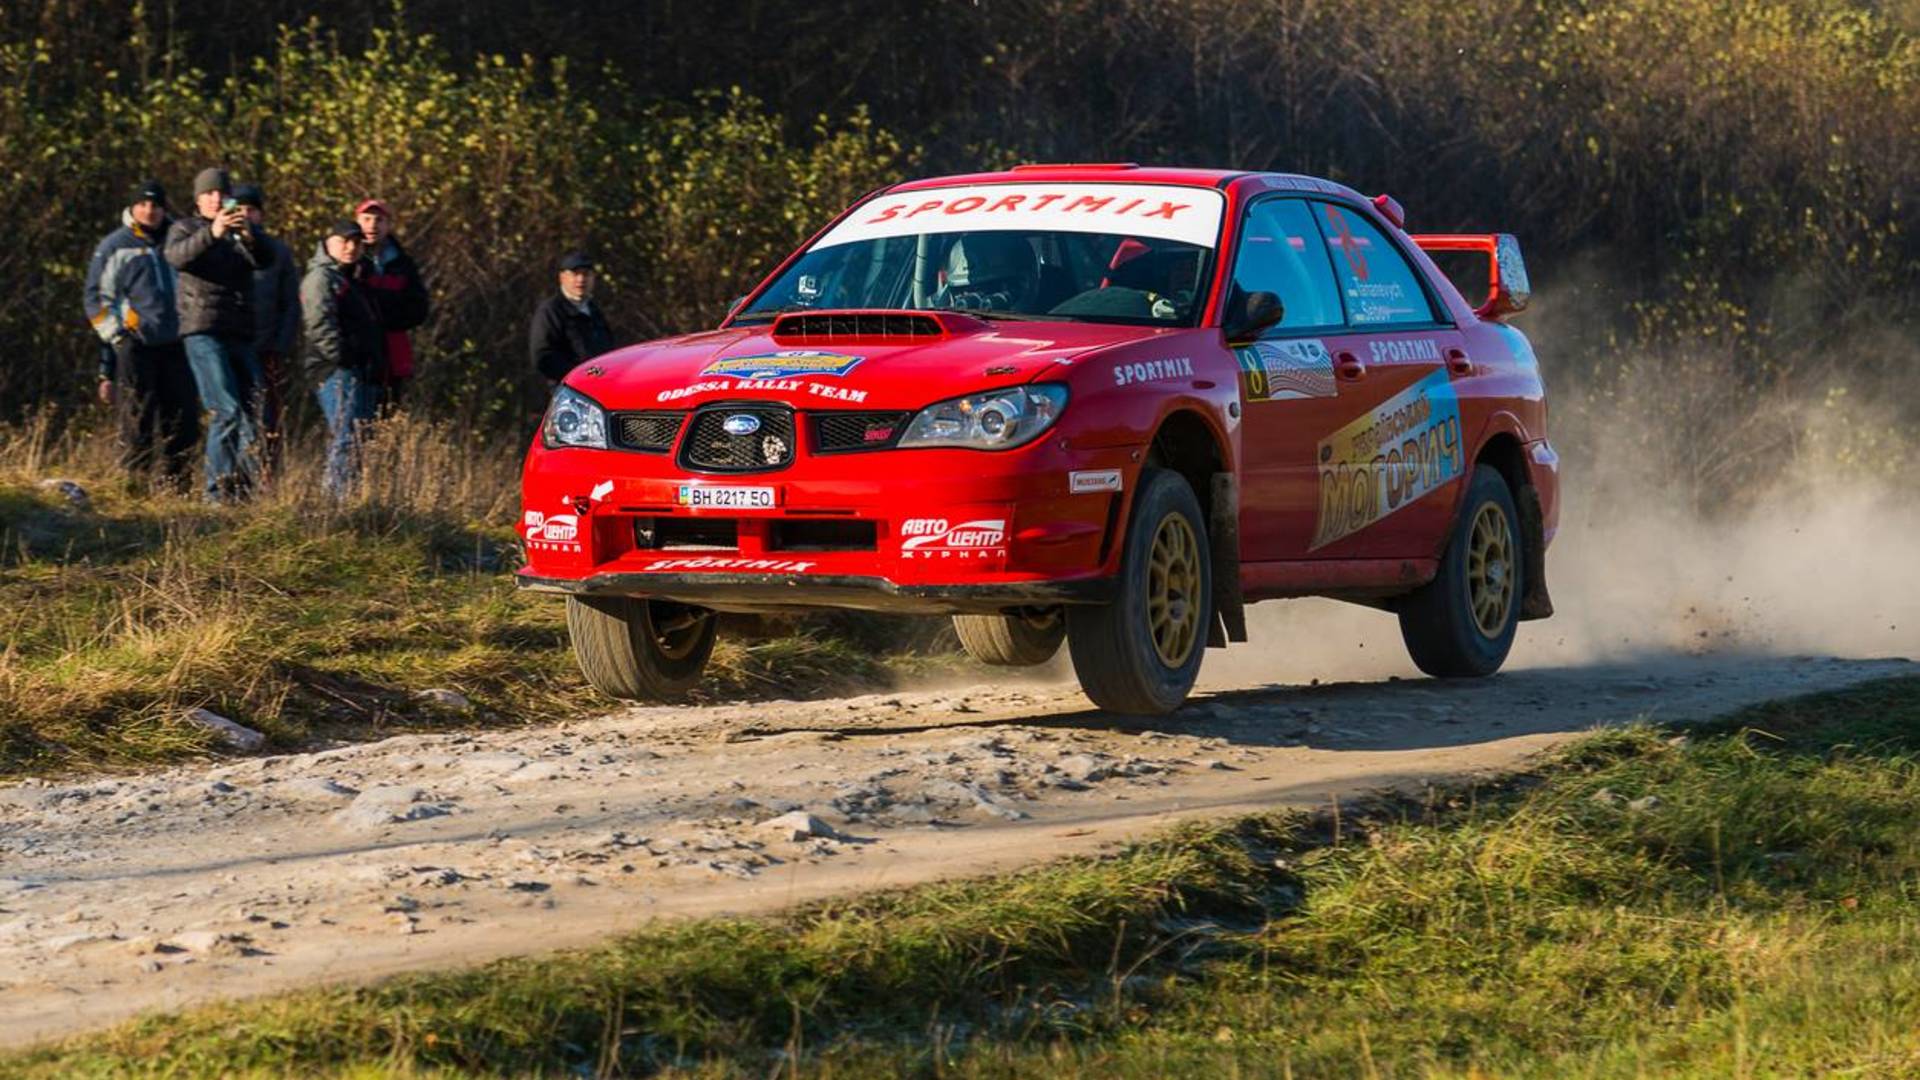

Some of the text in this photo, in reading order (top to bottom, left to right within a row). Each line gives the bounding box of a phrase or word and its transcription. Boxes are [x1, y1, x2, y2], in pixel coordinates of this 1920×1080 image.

[866, 193, 1193, 224] SPORTMIX
[1325, 203, 1369, 282] 8
[1369, 339, 1441, 363] SPORTMIX
[1113, 358, 1194, 386] SPORTMIX
[1244, 350, 1262, 394] 8
[656, 380, 868, 402] ODESSA RALLY TEAM
[1315, 415, 1459, 543] МОГОРИЧ
[692, 489, 770, 506] BH 8217 EO
[901, 518, 949, 537] АВТО
[946, 530, 1004, 547] ЦЕНТР
[643, 555, 818, 573] SPORTMIX
[901, 549, 1006, 559] ЖУРНАЛ
